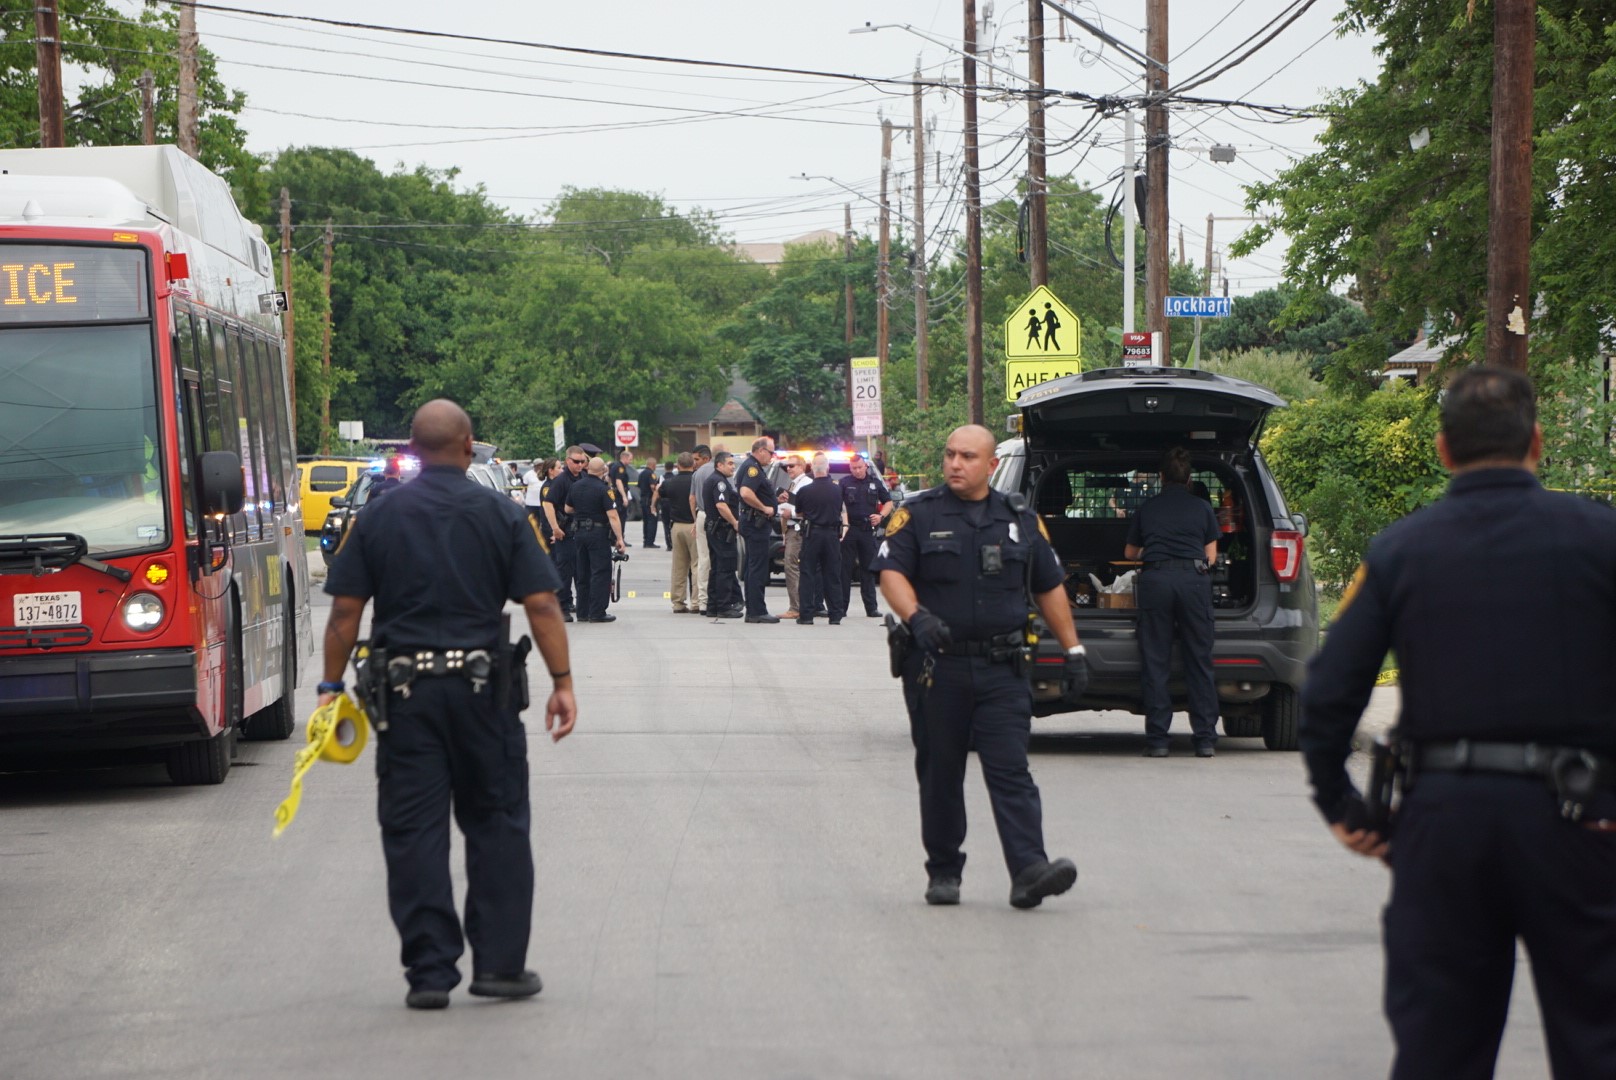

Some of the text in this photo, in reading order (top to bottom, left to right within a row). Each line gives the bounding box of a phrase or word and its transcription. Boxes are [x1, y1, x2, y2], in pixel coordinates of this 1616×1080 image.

[2, 263, 77, 304] ICE
[1167, 297, 1229, 313] Lockhart
[1013, 372, 1074, 388] AHE
[856, 384, 877, 399] 20
